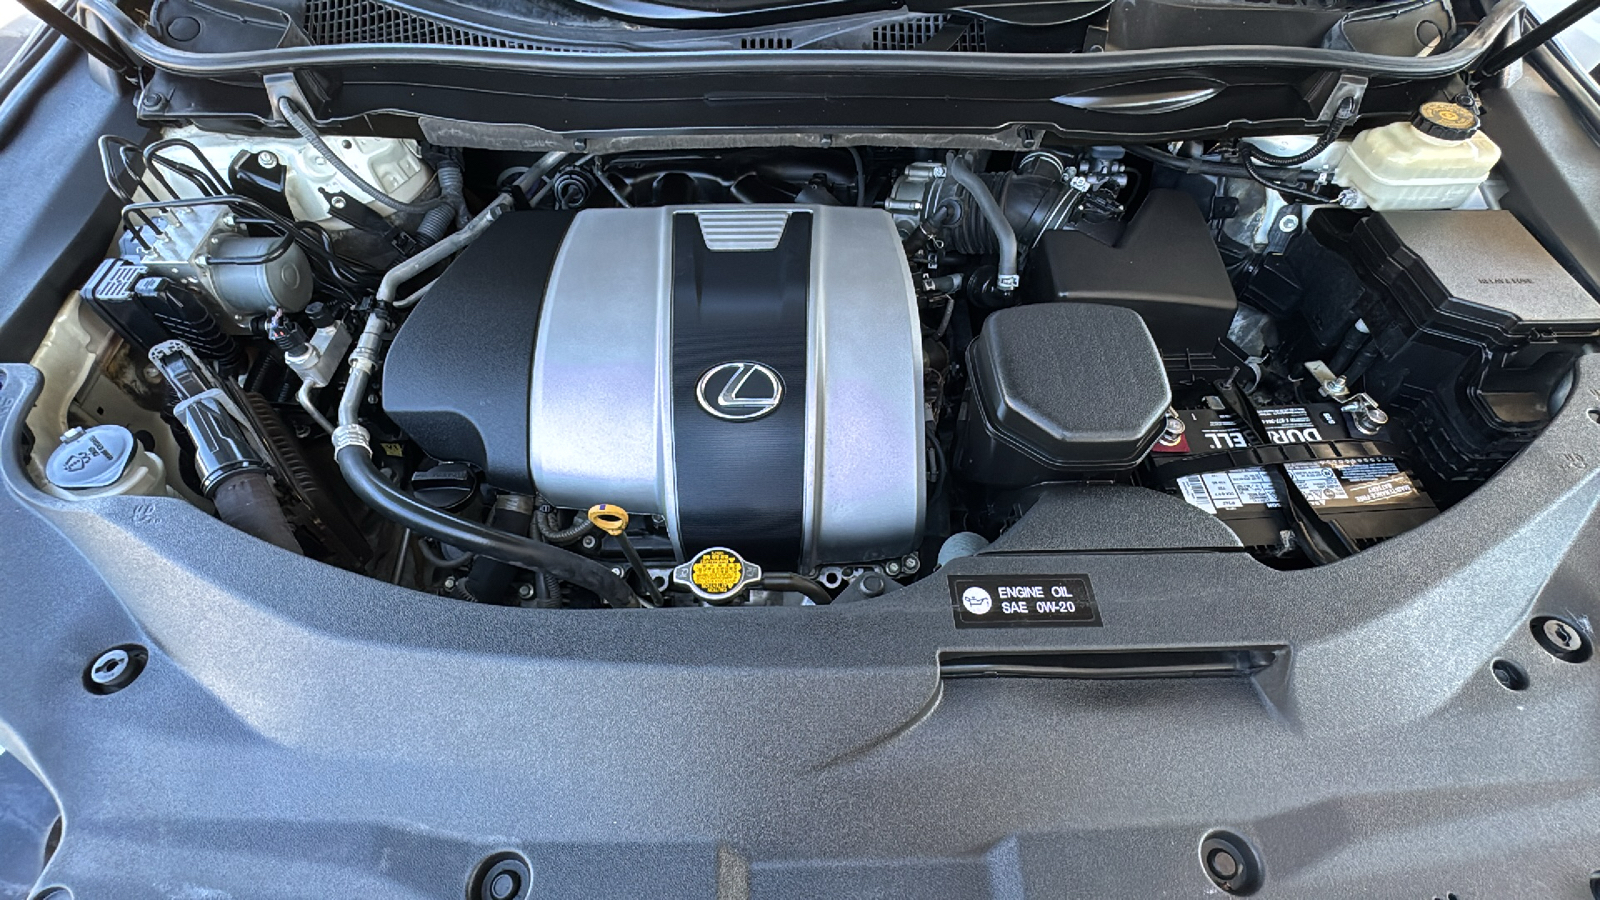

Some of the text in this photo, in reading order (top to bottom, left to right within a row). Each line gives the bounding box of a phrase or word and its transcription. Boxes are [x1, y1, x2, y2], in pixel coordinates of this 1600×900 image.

[998, 586, 1073, 599] ENGINE OIL
[1001, 601, 1076, 614] SAE 0W-20
